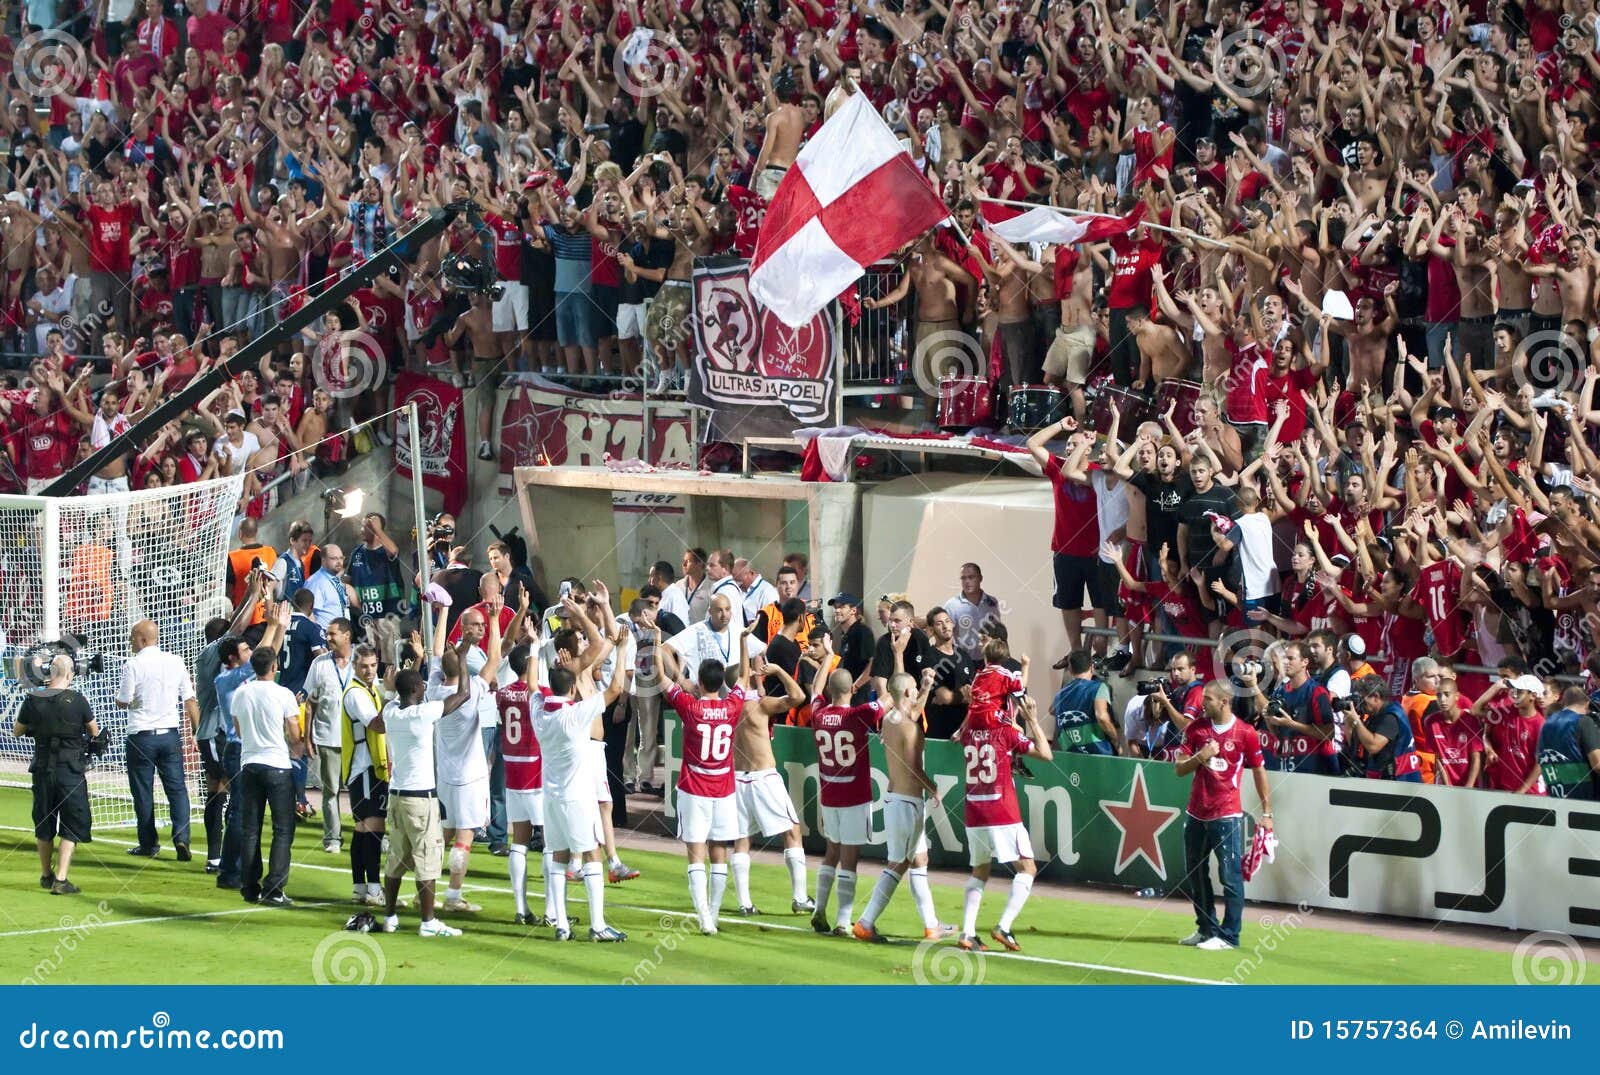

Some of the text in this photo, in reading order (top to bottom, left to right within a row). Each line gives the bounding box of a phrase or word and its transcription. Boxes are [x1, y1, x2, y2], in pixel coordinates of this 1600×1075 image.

[712, 375, 762, 392] ULTRAS
[362, 588, 379, 600] HB
[362, 601, 383, 614] 038
[505, 706, 522, 745] 6
[703, 708, 728, 720] ZAHAVI
[696, 723, 733, 761] 16
[815, 729, 857, 767] 26
[964, 743, 998, 784] 23
